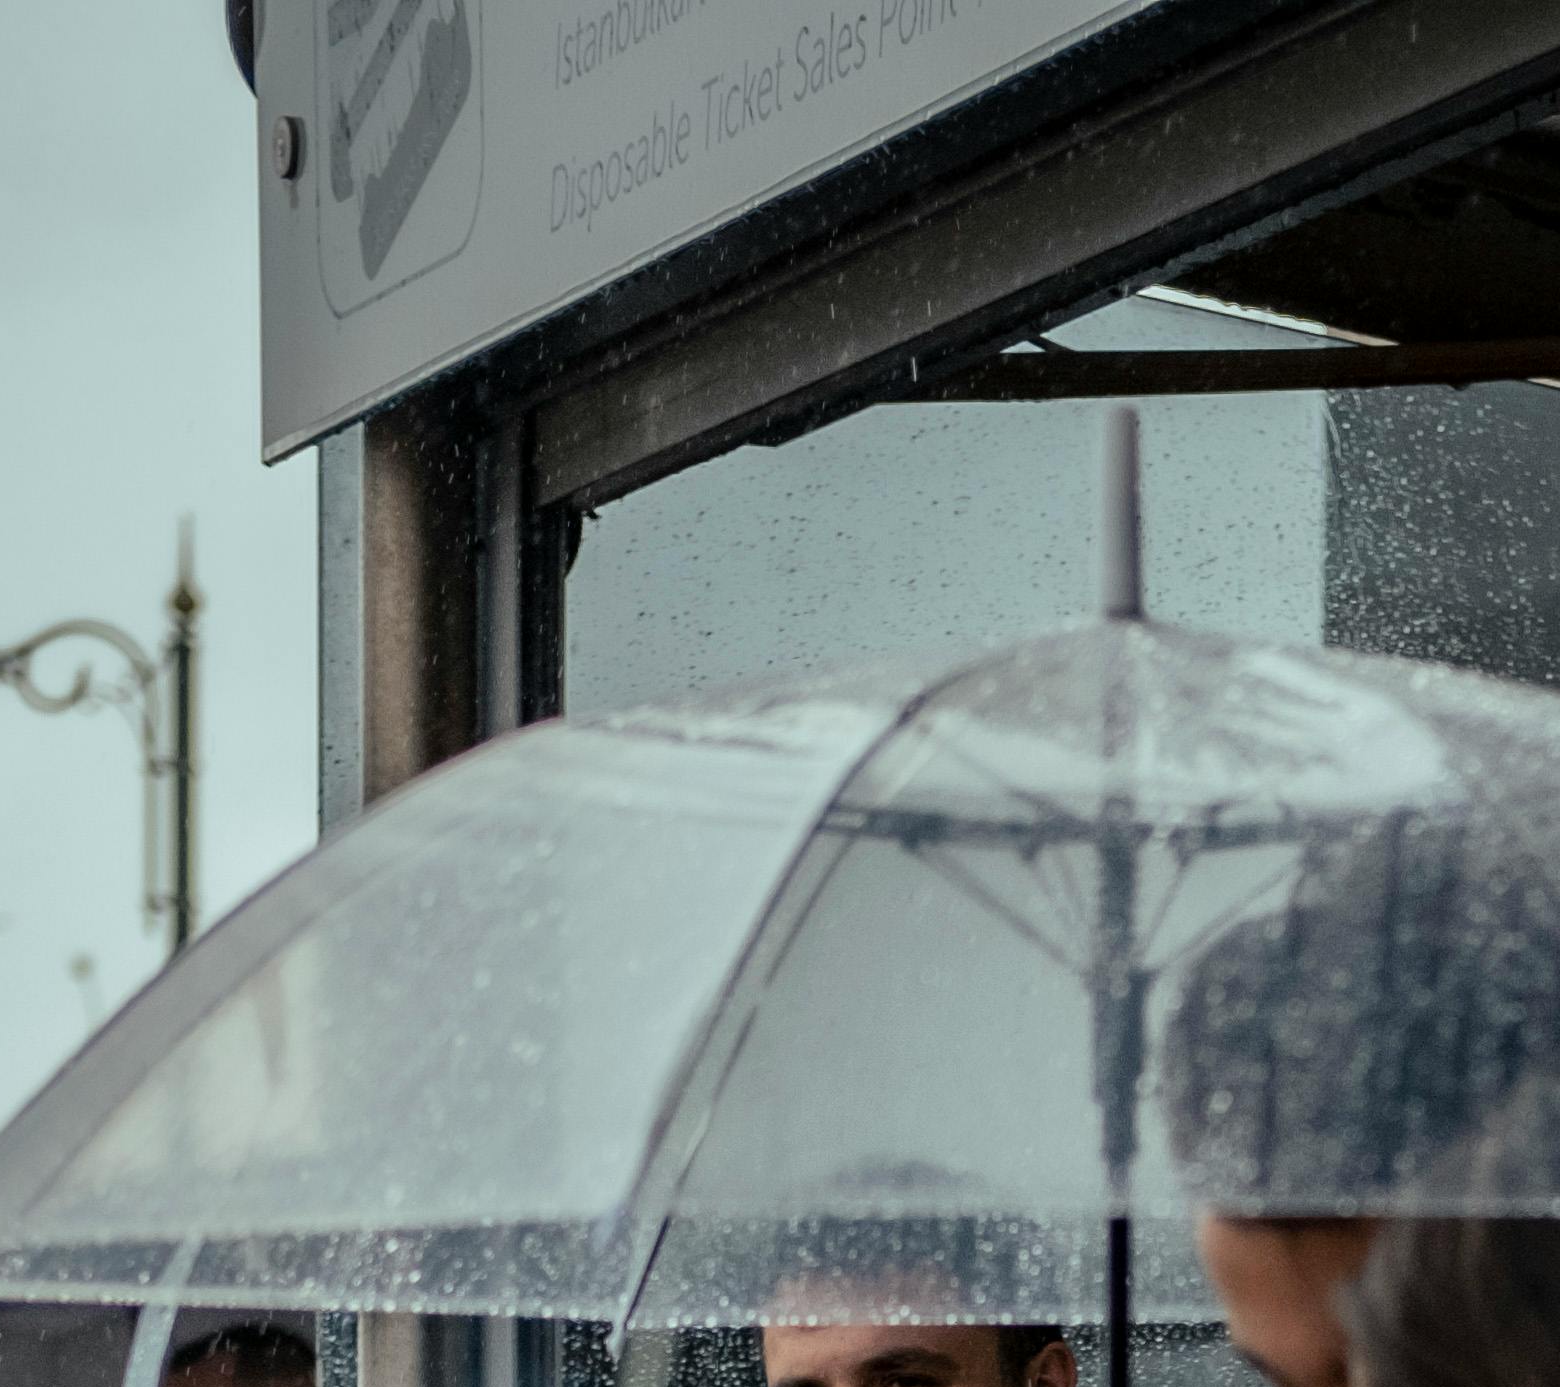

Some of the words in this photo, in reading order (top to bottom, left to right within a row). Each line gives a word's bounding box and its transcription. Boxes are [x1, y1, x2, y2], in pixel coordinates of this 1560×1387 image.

[550, 99, 691, 233] Disposable
[701, 47, 784, 150] Ticket
[793, 11, 867, 102] Sales
[555, 0, 706, 90] Istanbulka
